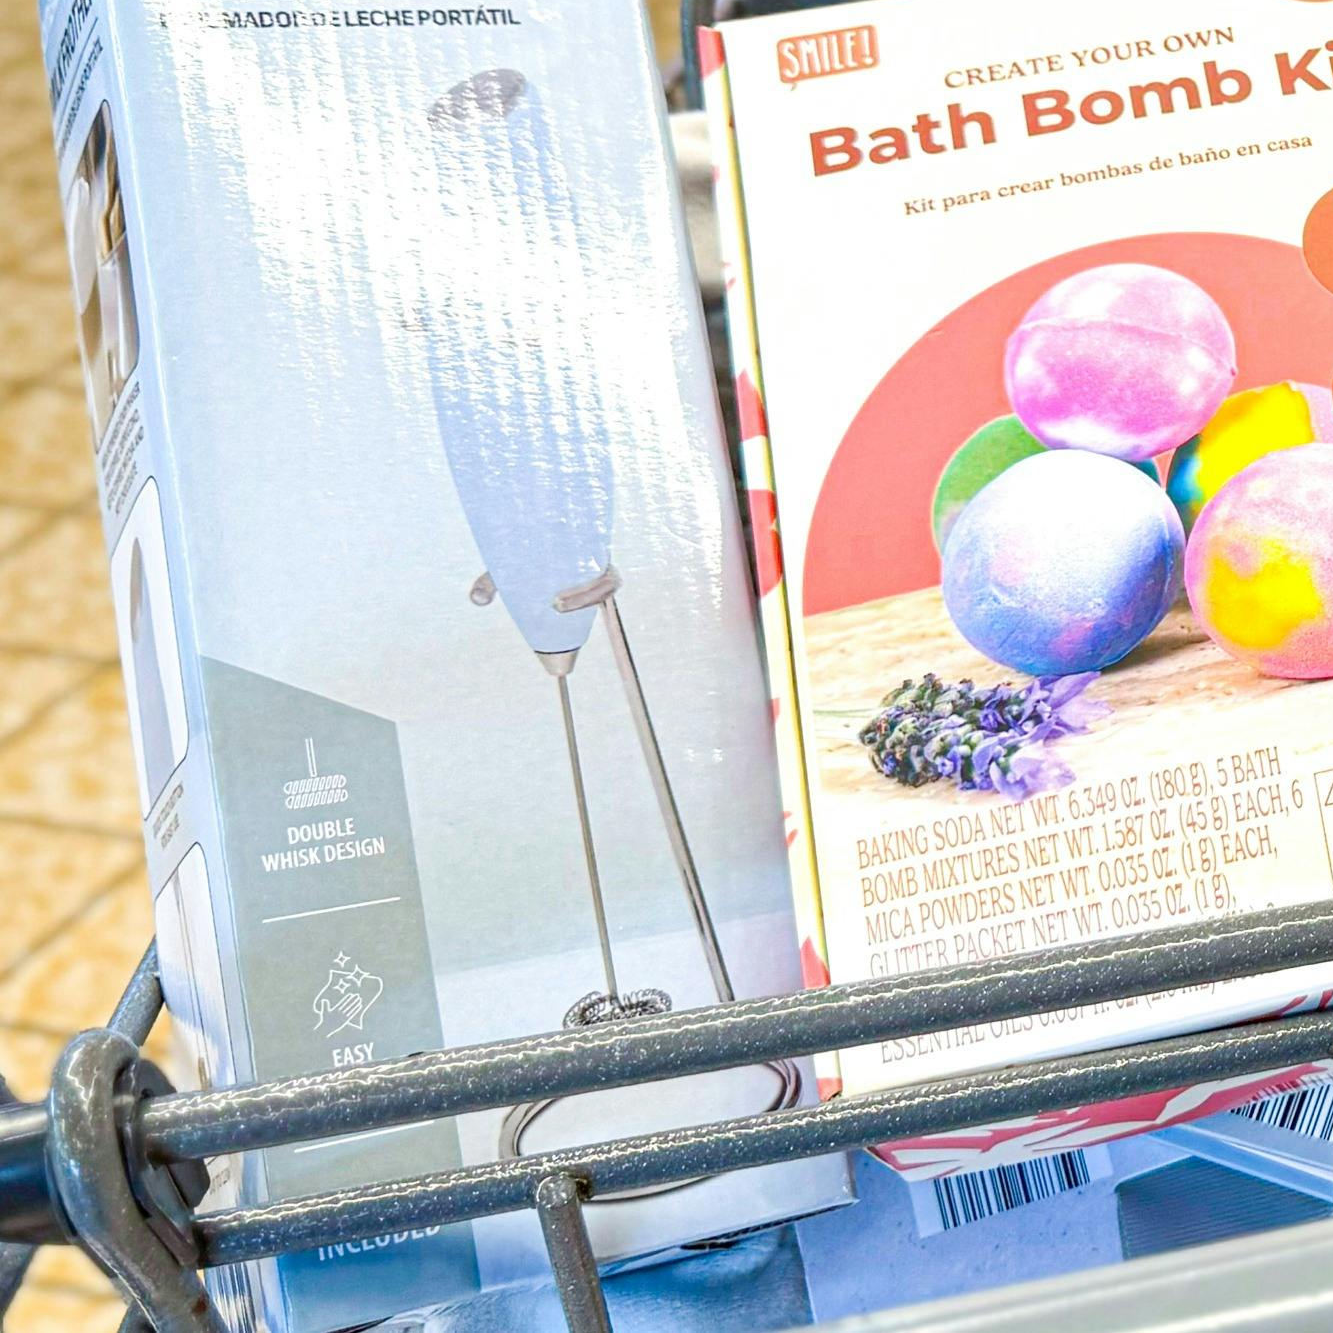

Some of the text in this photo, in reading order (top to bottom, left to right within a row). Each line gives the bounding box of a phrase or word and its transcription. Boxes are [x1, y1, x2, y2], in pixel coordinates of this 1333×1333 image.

[344, 8, 414, 28] LECHE
[417, 4, 522, 28] PORTÁTIL
[779, 27, 875, 80] SMILE!
[943, 25, 1236, 90] CREATE YOUR OWN
[809, 102, 998, 178] Bath
[1021, 59, 1254, 138] Bomb
[903, 134, 1314, 216] Kit para crear bombas de baño en casa
[286, 817, 357, 845] DOUBLE
[856, 824, 930, 871] BAKING
[932, 812, 987, 852] SODA
[990, 801, 1027, 839] NET
[1030, 793, 1066, 828] WT.
[1068, 781, 1118, 820] 6.349
[1120, 775, 1146, 809] OZ.
[1149, 767, 1187, 807] (180
[1216, 757, 1228, 788] 5
[1231, 745, 1282, 785] BATH
[260, 835, 386, 873] WHISK DESIGN
[860, 778, 1305, 909] BOMB MIXTURES NET WT. 1.587 OZ. (45 g) EACH, 6
[864, 824, 1279, 947] MICA POWDERS NET WT. 0.035 OZ. (1 g) EACH,
[869, 937, 950, 978] GLITTER
[952, 918, 1027, 965] PACKET
[1031, 909, 1069, 948] NET
[1071, 901, 1109, 938] WT.
[1110, 888, 1163, 930] 0.035
[1164, 881, 1191, 918] OZ.
[1194, 877, 1210, 916] (1
[331, 1041, 375, 1068] EASY
[880, 1026, 987, 1065] ESSENTIAL
